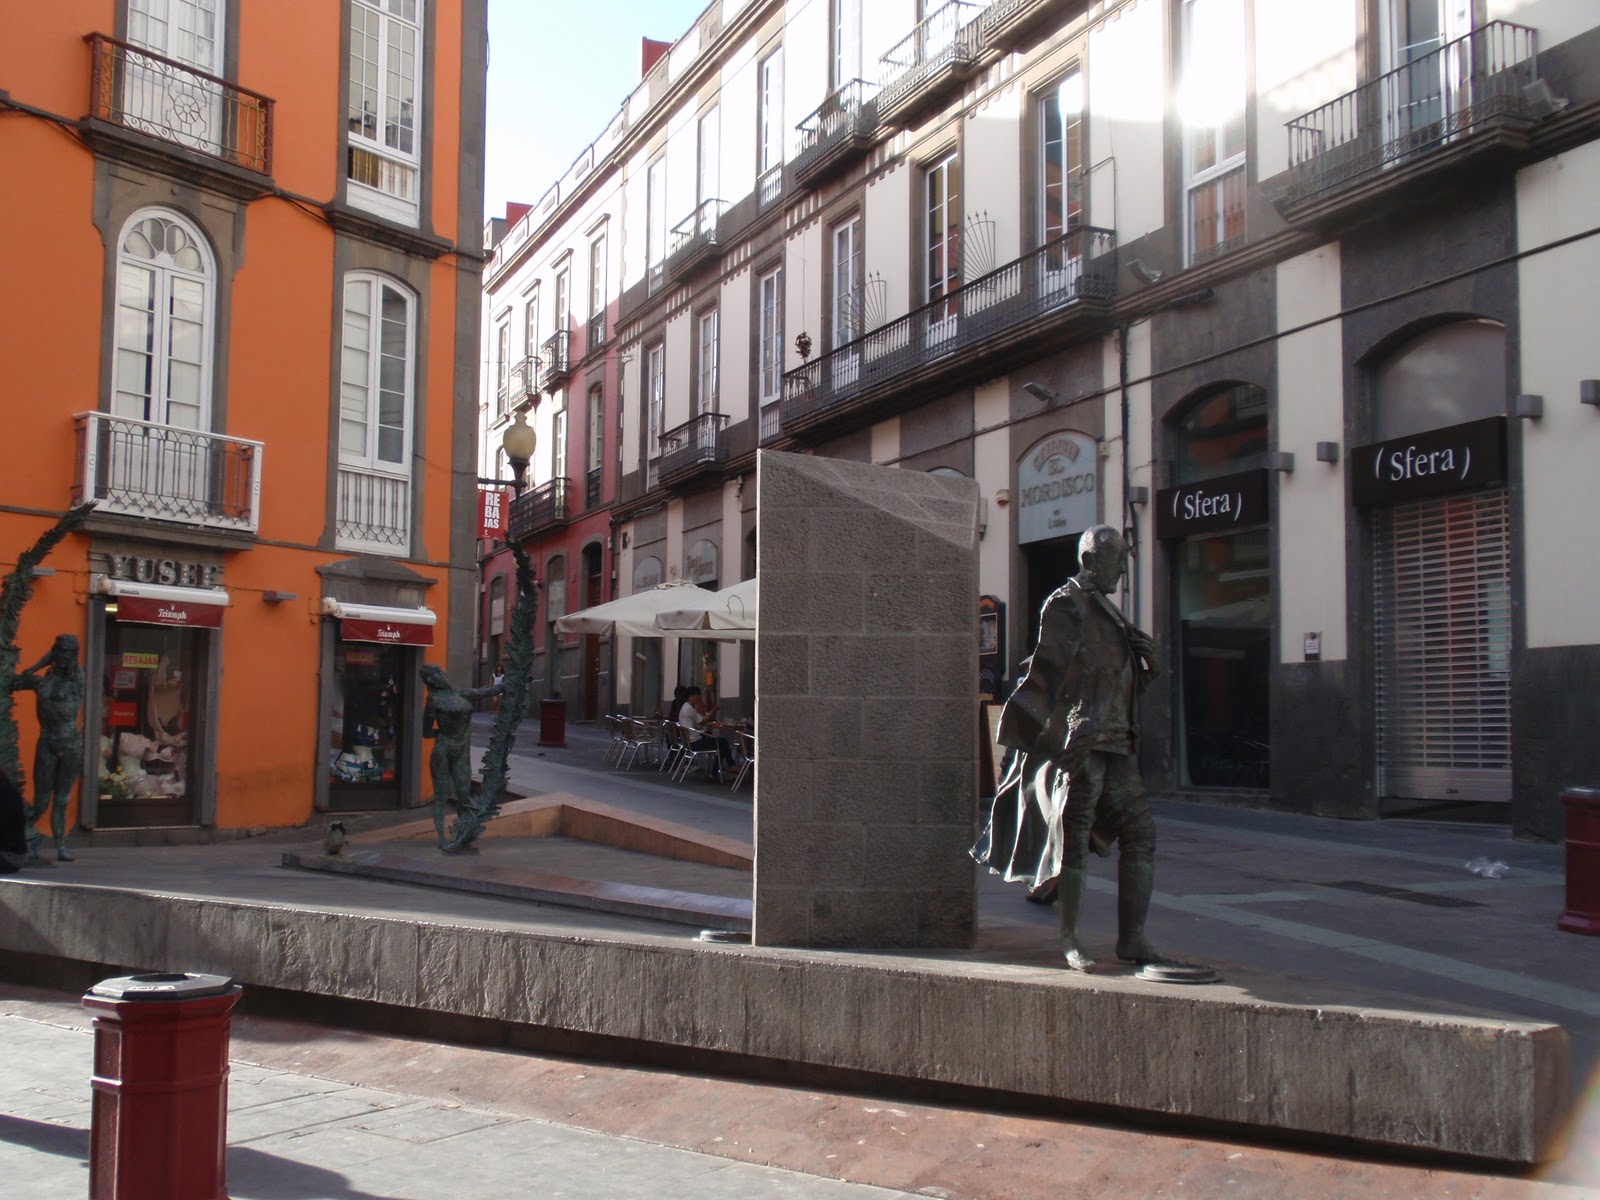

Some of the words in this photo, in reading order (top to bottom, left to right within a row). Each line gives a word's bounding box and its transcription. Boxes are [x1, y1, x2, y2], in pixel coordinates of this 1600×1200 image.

[1021, 473, 1094, 507] MORDISCO
[485, 492, 500, 506] RE
[485, 505, 500, 519] BA
[484, 518, 500, 529] JAS
[158, 608, 187, 620] Triumph
[377, 629, 400, 639] Triumph
[123, 655, 158, 665] REBAJAS
